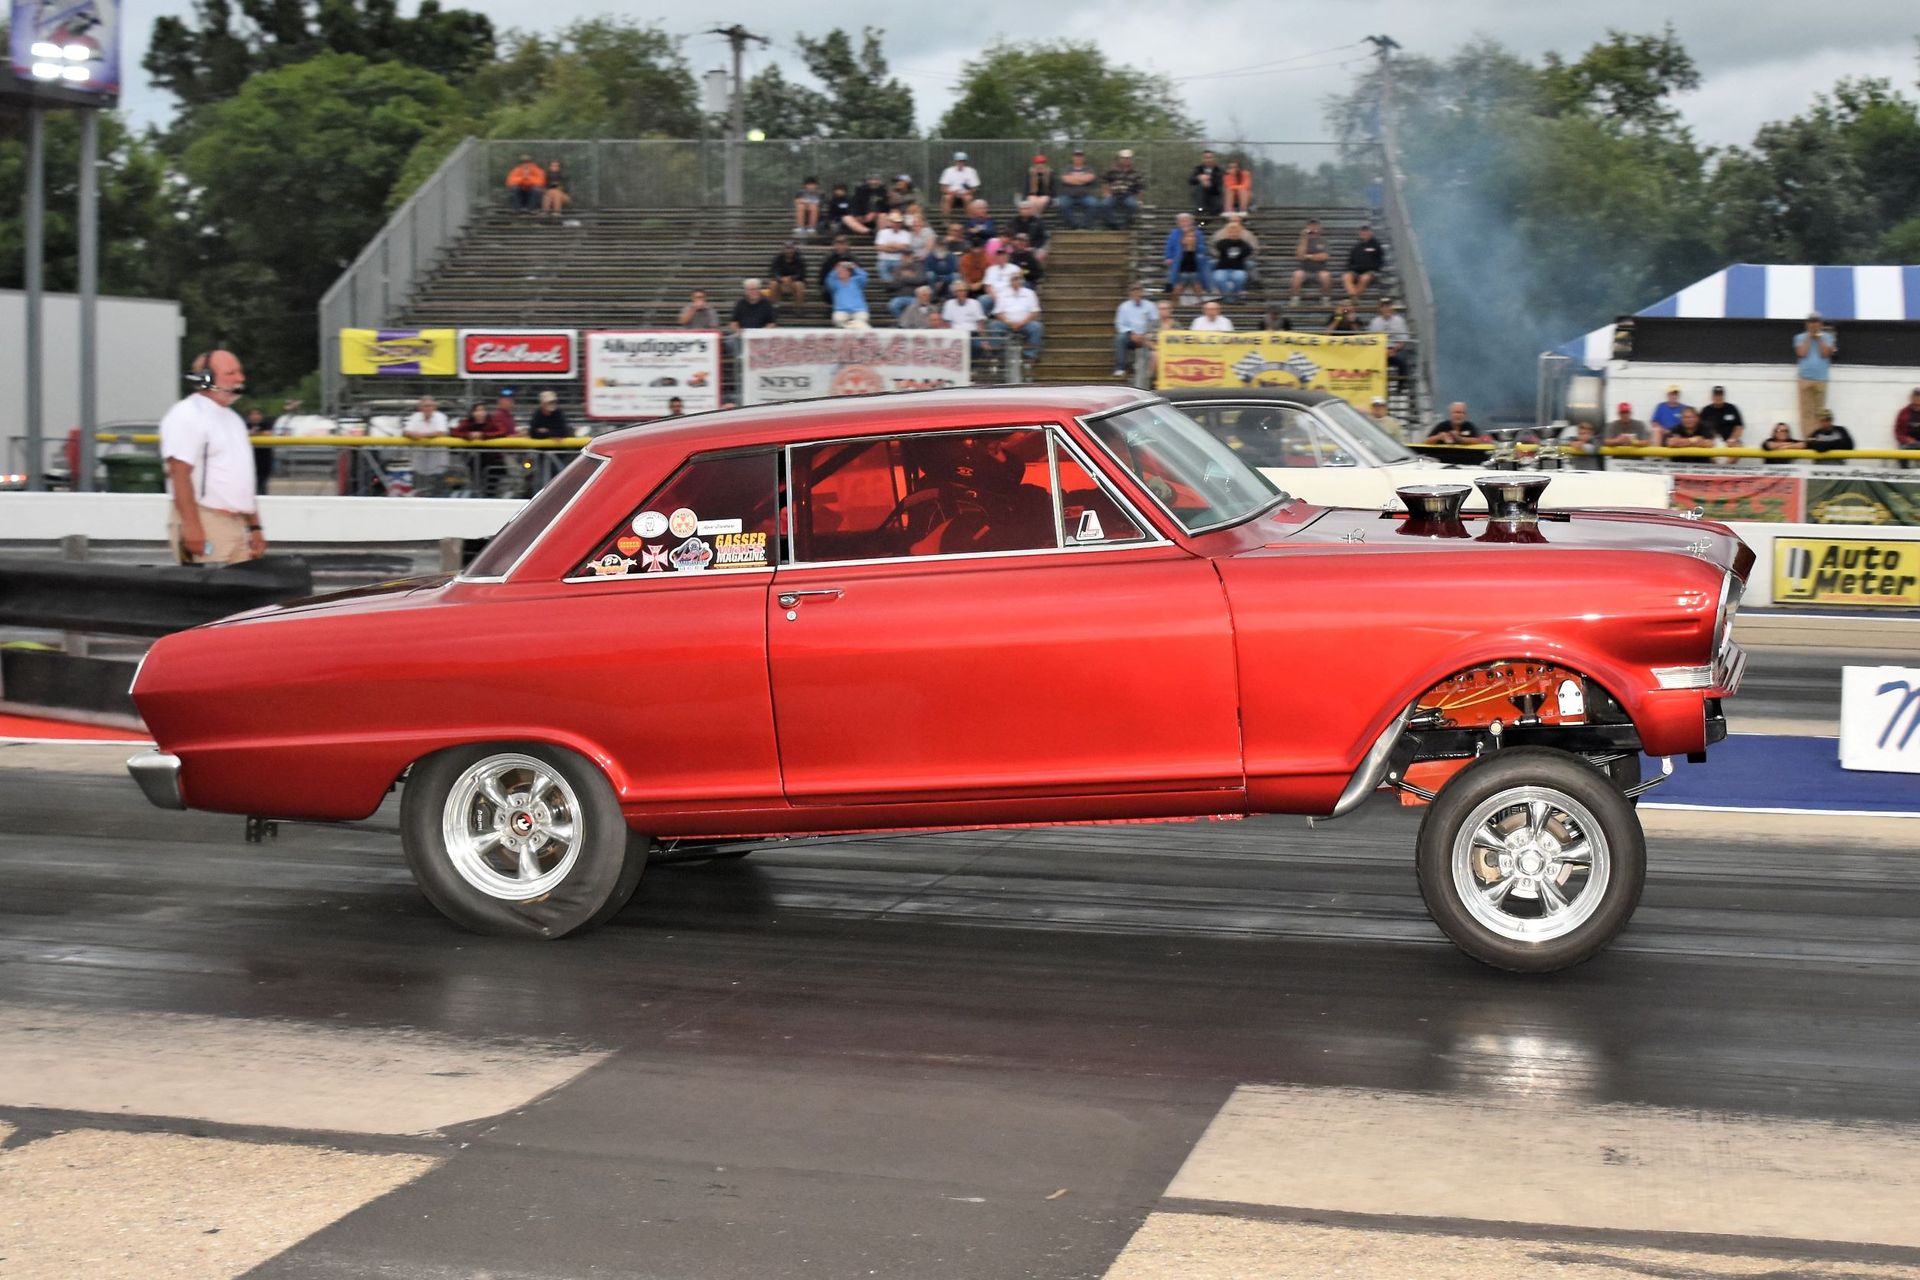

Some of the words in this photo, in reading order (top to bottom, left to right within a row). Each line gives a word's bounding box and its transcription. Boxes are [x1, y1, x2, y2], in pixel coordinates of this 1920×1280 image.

[1165, 334, 1263, 346] WELCOME
[1270, 334, 1321, 346] RACE
[1327, 336, 1379, 347] FANS
[472, 342, 564, 364] Edelbrock
[758, 375, 811, 389] NFG
[715, 532, 767, 547] GASSER
[1819, 545, 1901, 571] Auto
[1816, 569, 1917, 596] Meter
